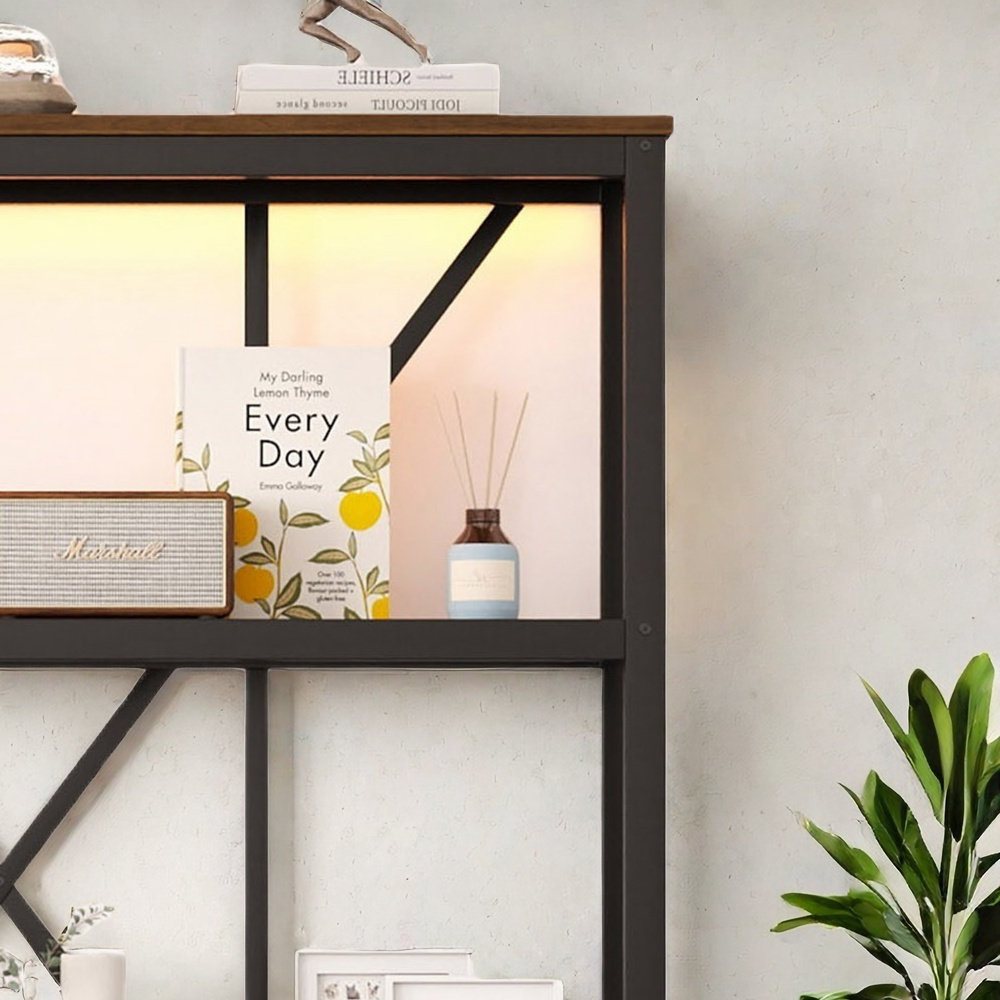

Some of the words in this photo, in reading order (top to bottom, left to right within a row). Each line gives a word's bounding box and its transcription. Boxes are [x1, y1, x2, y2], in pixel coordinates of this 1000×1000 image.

[259, 370, 277, 385] My
[281, 370, 324, 385] Darling
[253, 386, 290, 399] Lemon
[293, 386, 331, 400] Thyme
[245, 403, 339, 442] Every
[259, 439, 326, 478] Day
[259, 481, 284, 491] Emma
[285, 481, 323, 493] Galloway
[53, 535, 166, 561] Marshall
